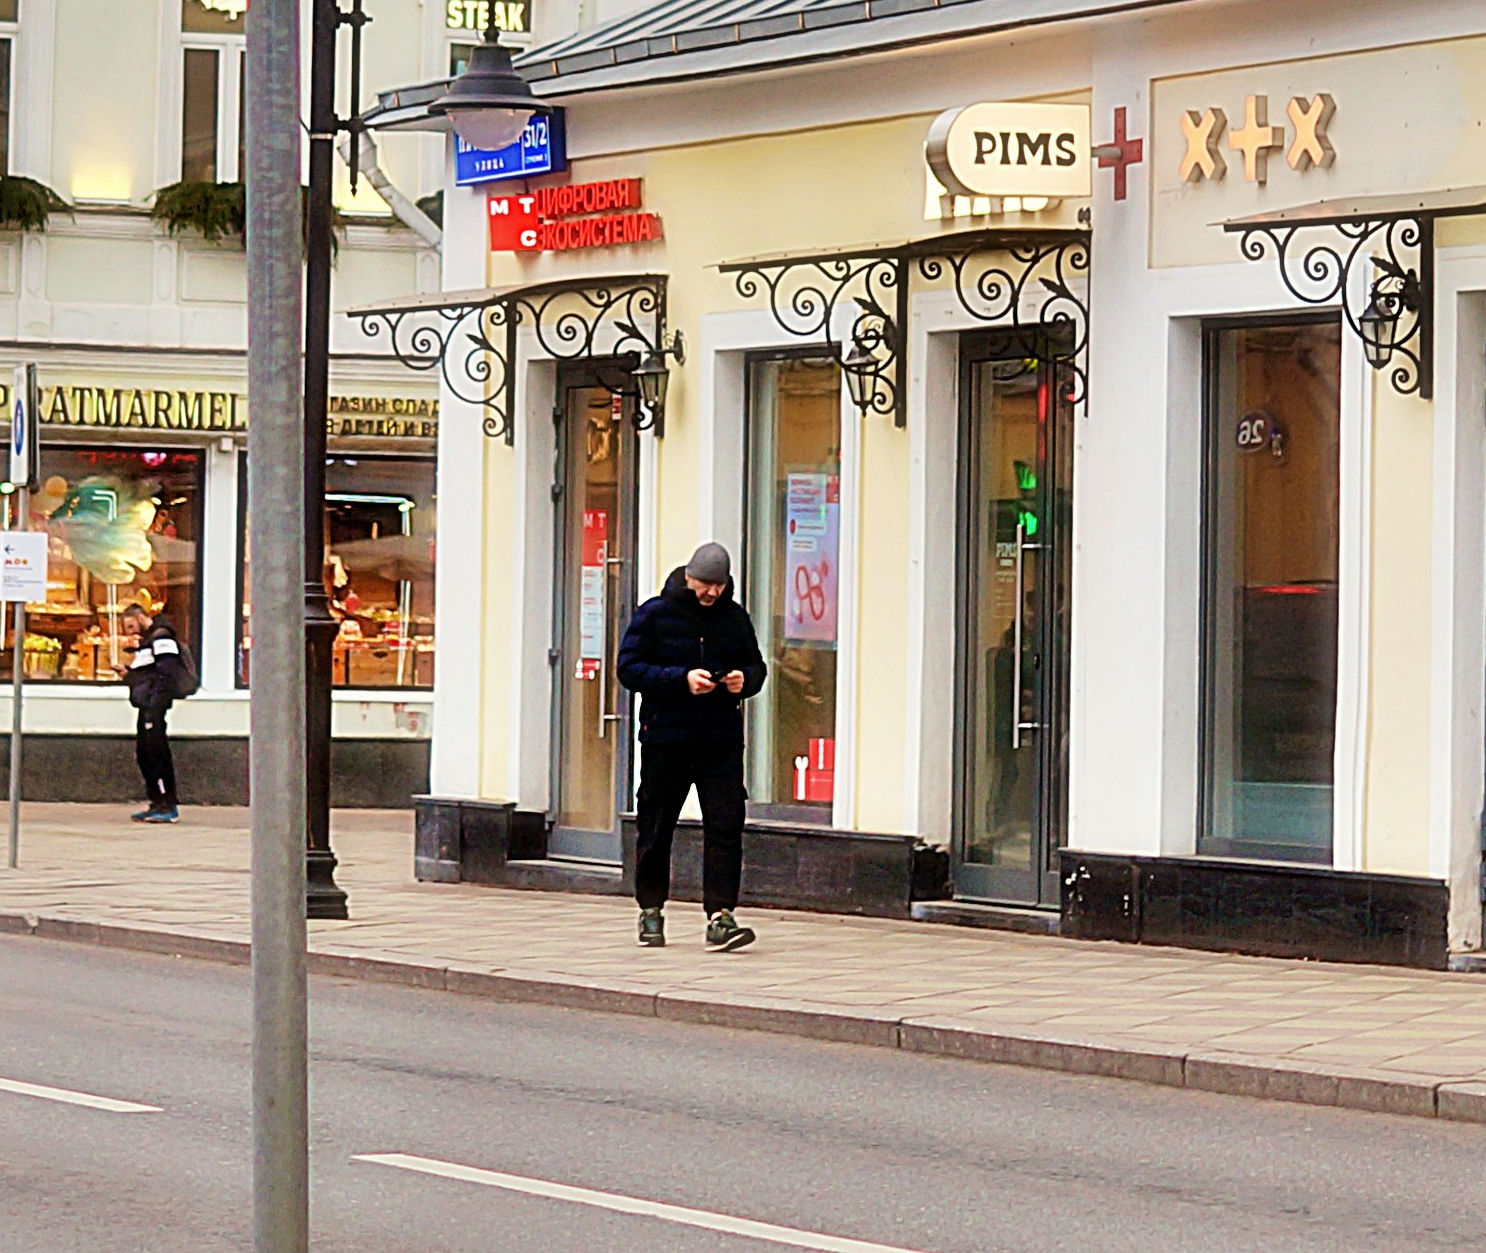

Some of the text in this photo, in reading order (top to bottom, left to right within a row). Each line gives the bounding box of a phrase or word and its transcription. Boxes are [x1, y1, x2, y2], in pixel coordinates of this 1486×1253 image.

[524, 122, 548, 149] 31/2
[973, 131, 1077, 167] PIMS
[535, 177, 631, 218] ЦИФРОВАЯ
[539, 213, 653, 250] ЭКОСИСТЕМА
